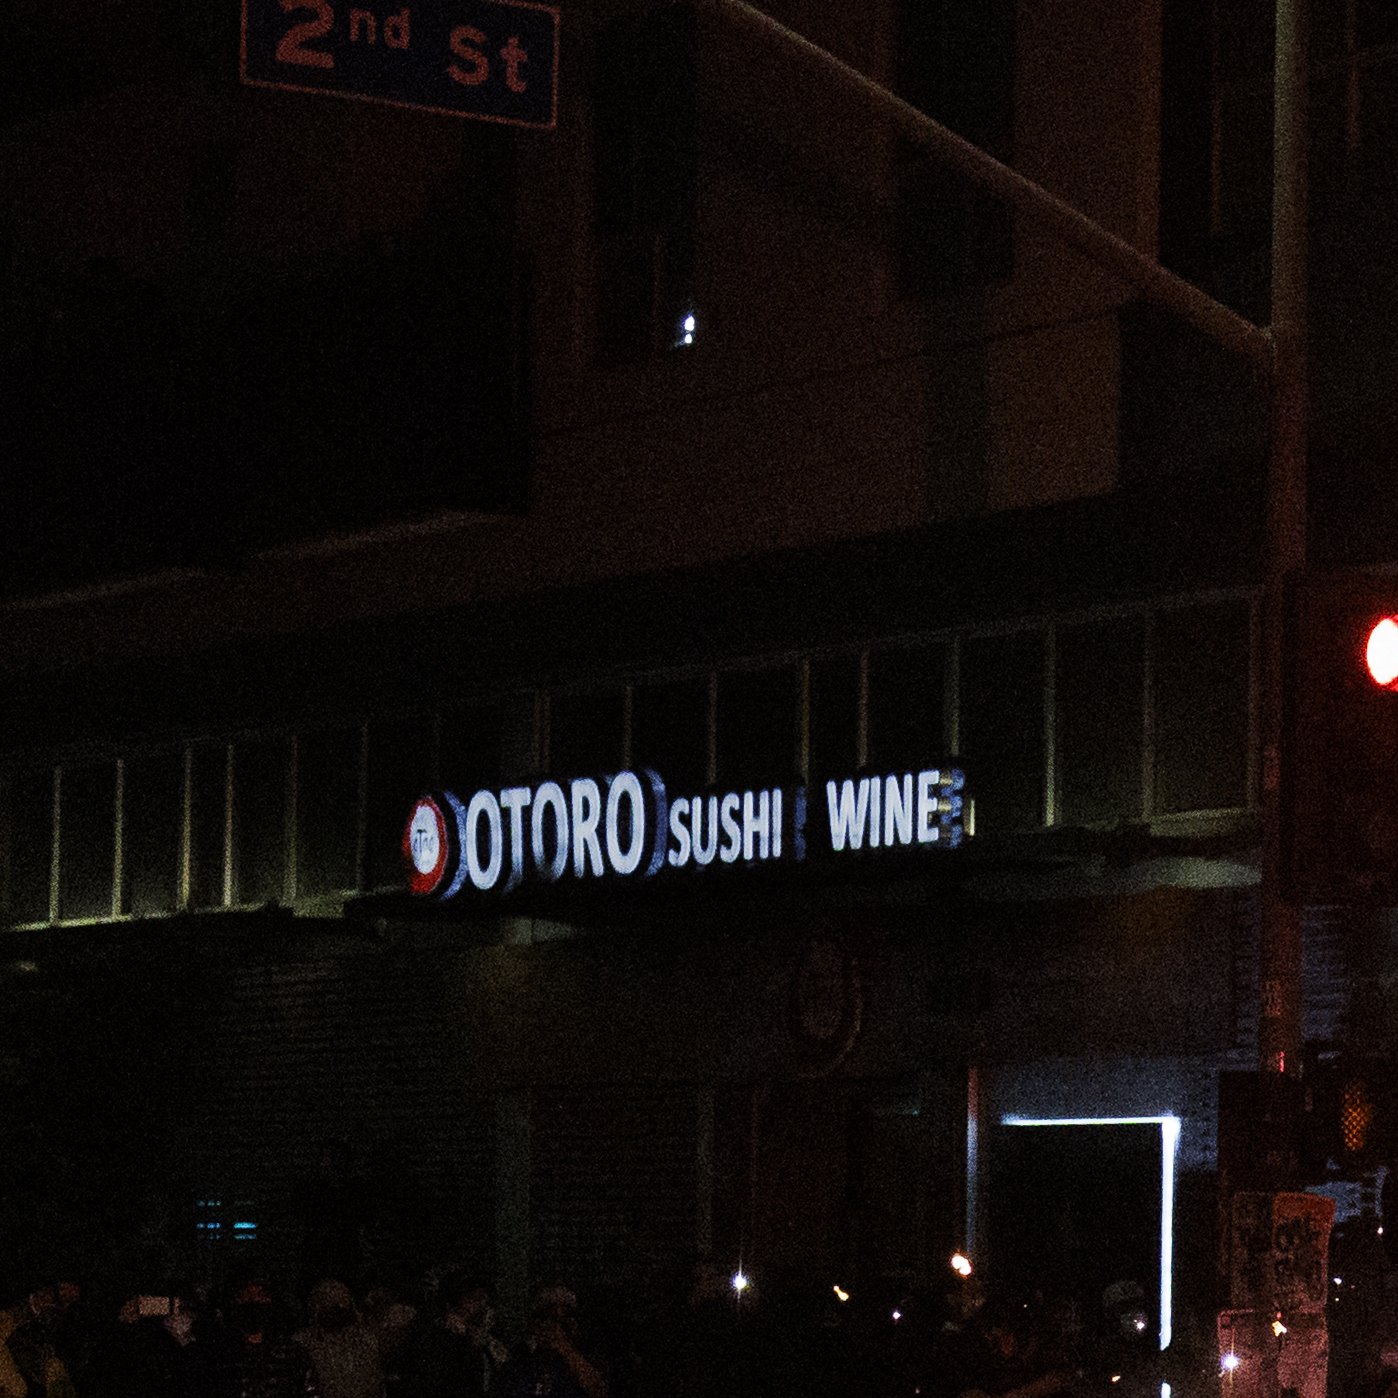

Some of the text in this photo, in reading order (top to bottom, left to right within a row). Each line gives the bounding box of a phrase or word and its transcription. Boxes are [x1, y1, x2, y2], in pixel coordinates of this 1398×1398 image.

[274, 0, 529, 94] 2nd St
[466, 770, 646, 890] OTORO
[667, 788, 783, 867] SUSHI
[826, 769, 941, 851] WINE
